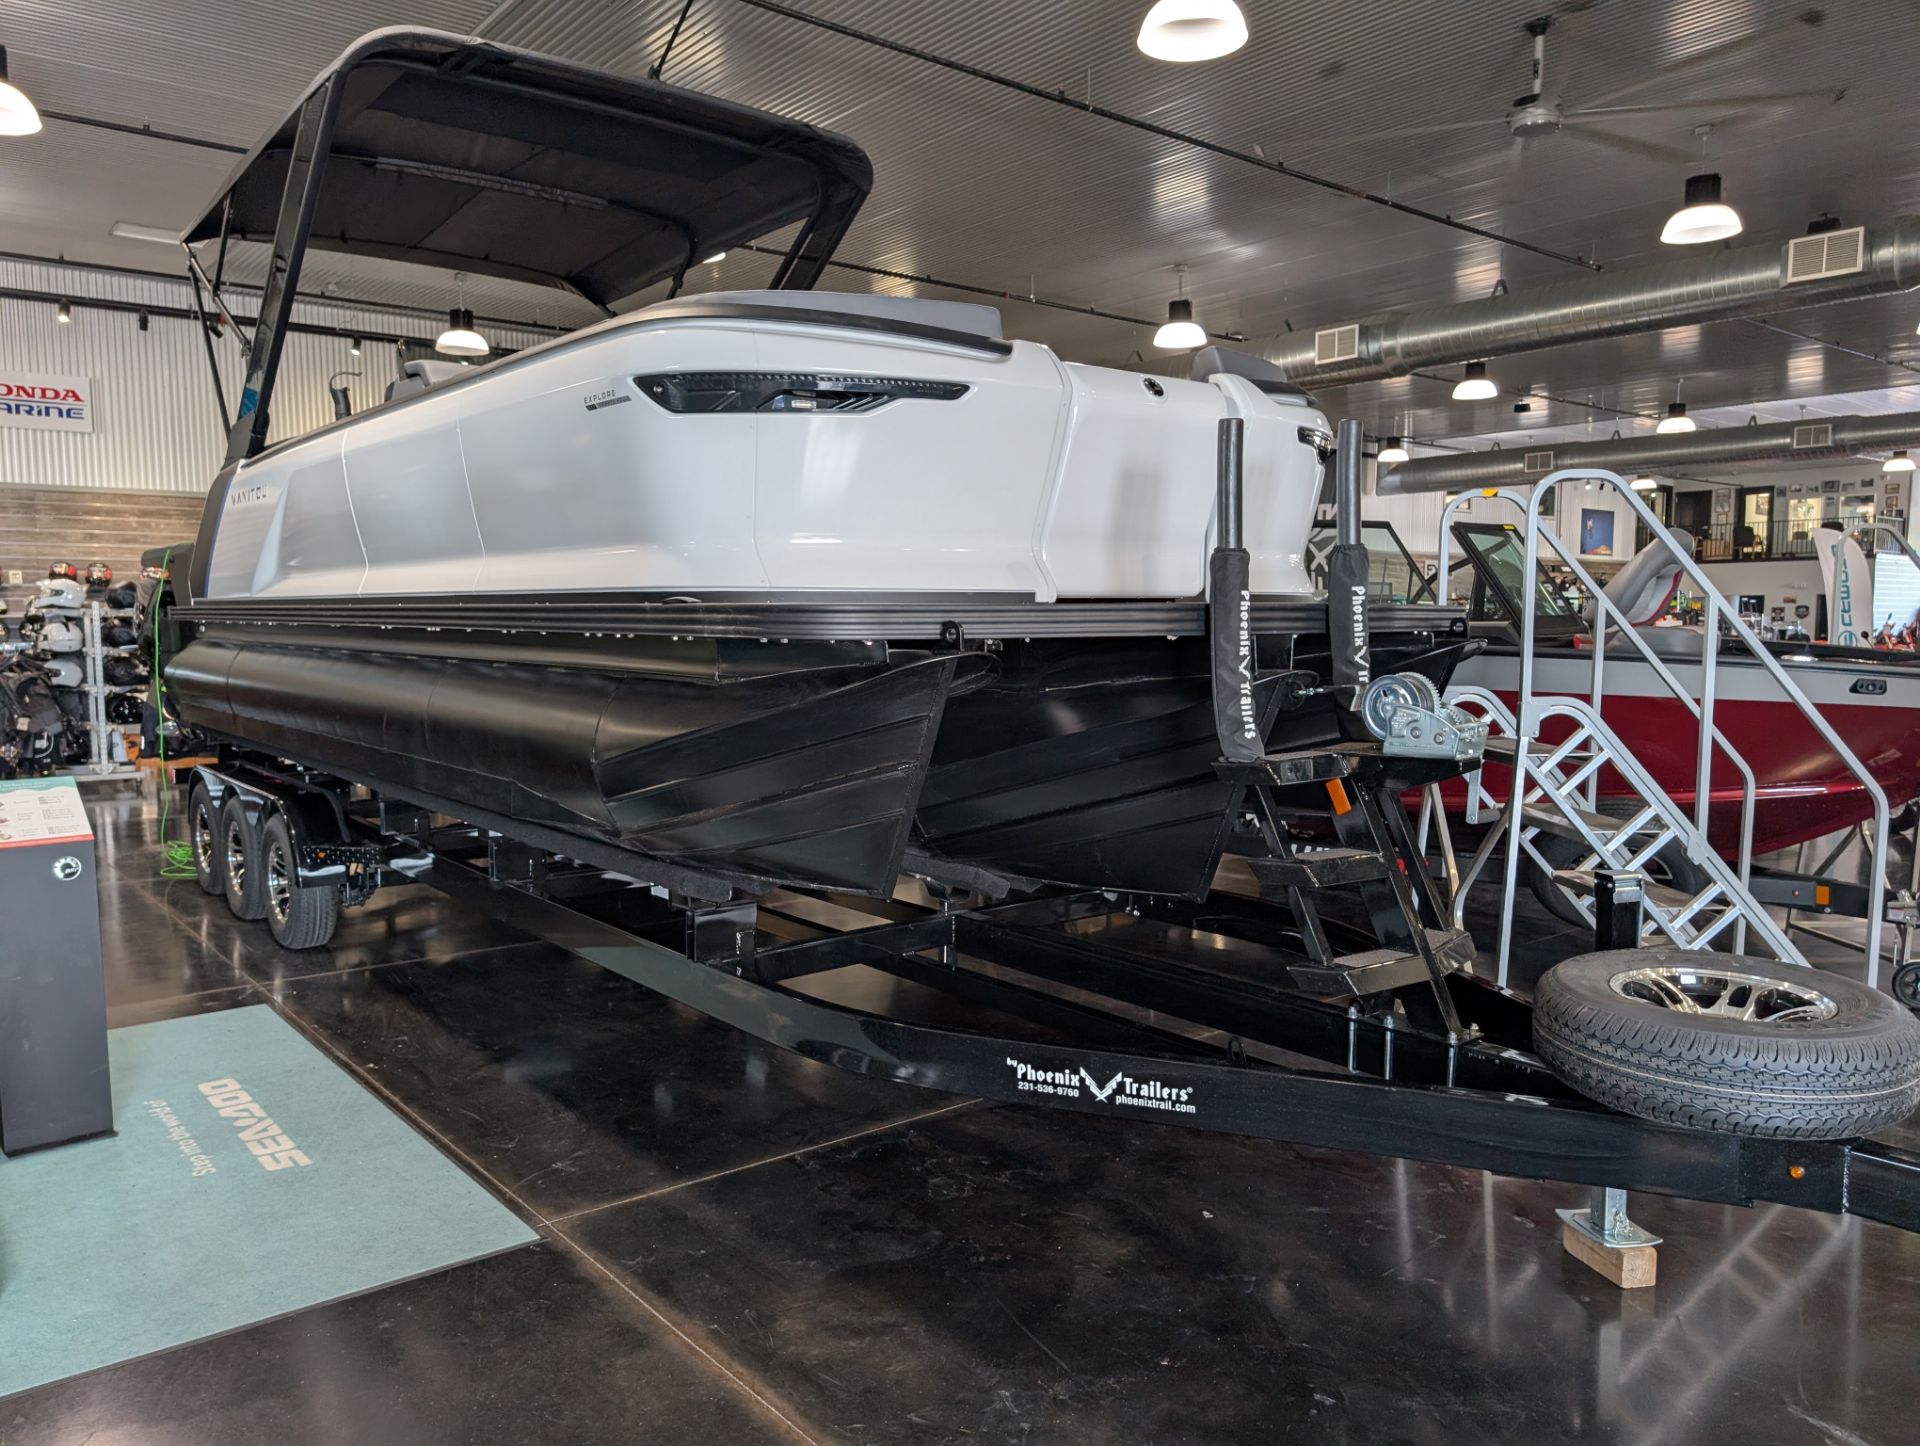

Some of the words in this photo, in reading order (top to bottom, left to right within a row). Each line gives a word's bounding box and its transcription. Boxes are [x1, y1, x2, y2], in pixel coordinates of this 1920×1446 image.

[583, 389, 617, 404] EXPLORE
[1239, 589, 1251, 656] Phoenix
[1352, 585, 1367, 647] Phoenix
[1240, 681, 1257, 739] Trailers
[1016, 1063, 1080, 1088] Phoenix
[1018, 1081, 1080, 1098] 231-536-9760
[1115, 1094, 1196, 1114] phoenixtrail.com
[191, 1153, 217, 1177] Step
